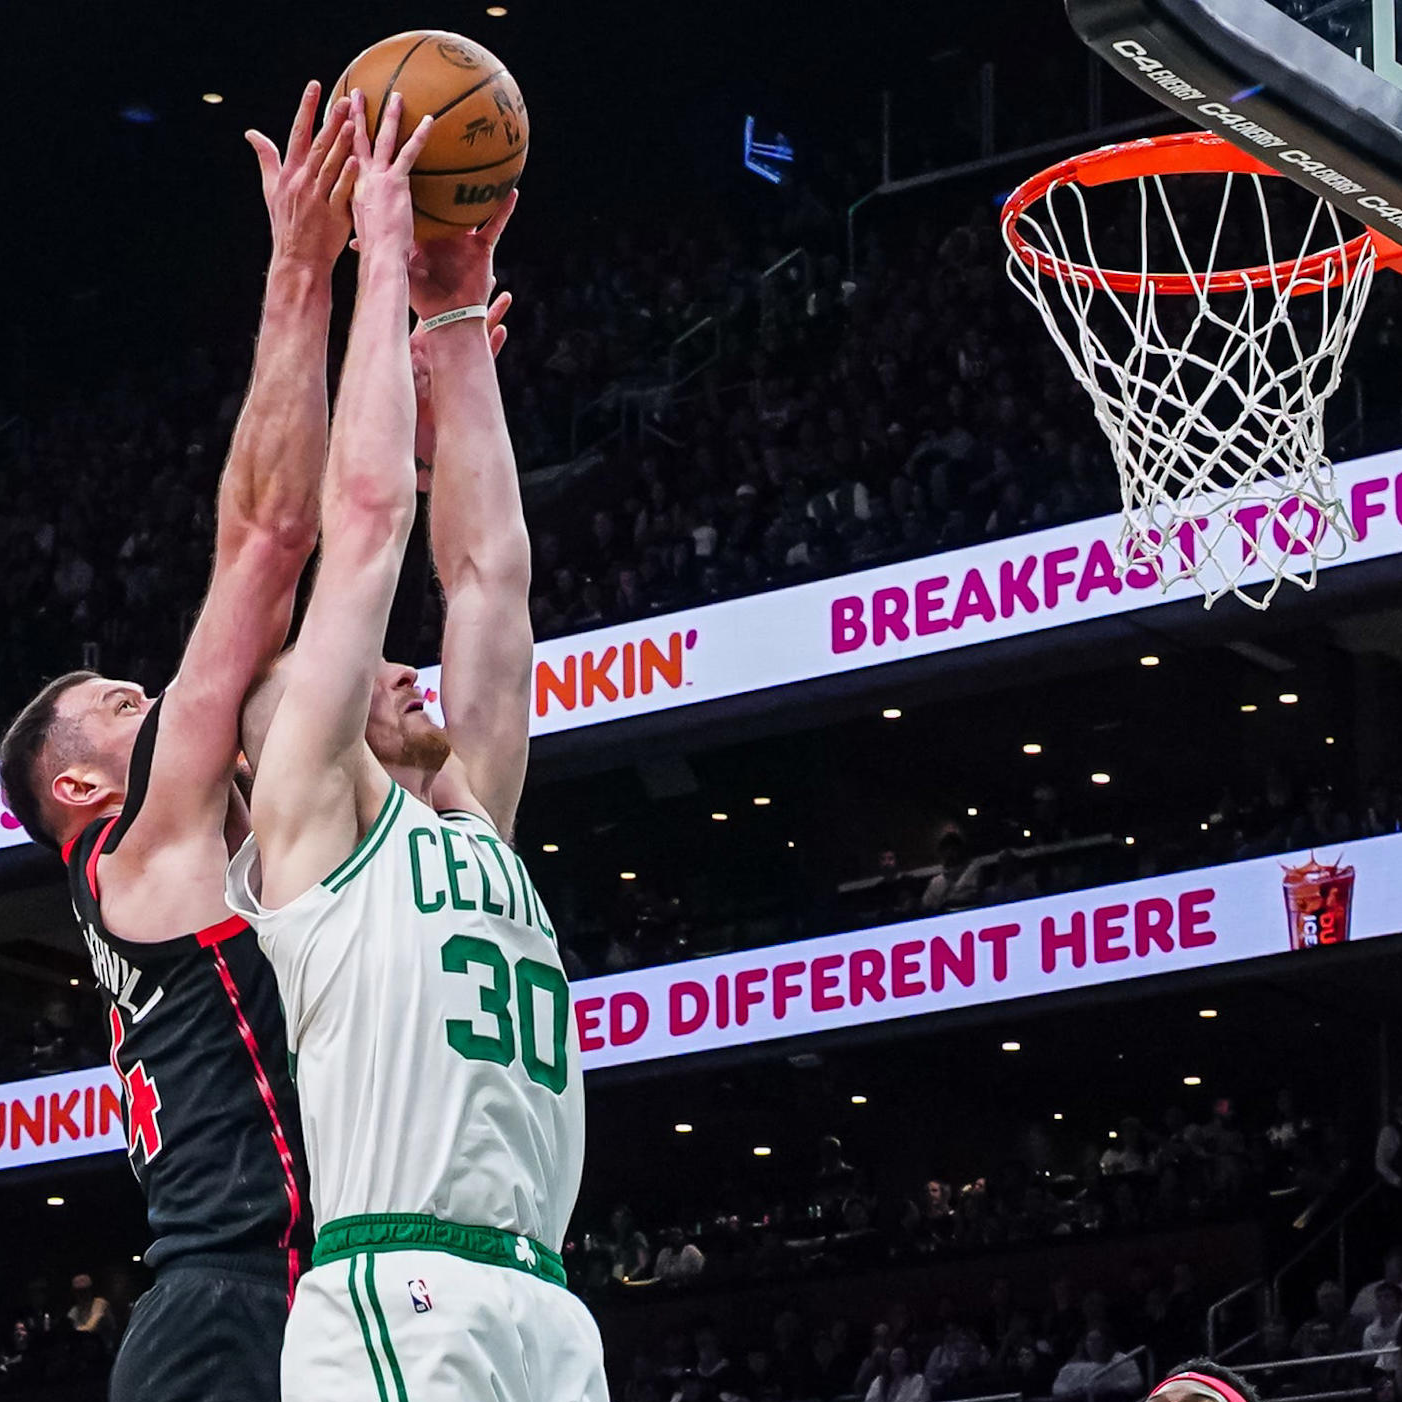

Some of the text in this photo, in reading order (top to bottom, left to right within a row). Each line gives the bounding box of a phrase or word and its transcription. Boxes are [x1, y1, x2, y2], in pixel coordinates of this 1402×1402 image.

[1112, 40, 1206, 101] C4 ENERGY
[1198, 102, 1287, 149] C4 ENERGY
[1278, 150, 1367, 195] C4 ENERGY
[1357, 196, 1402, 222] C4
[832, 519, 1208, 653] BREAKFAST
[1232, 498, 1325, 565] TO
[537, 630, 697, 716] NKIN'
[575, 889, 1216, 1051] ED DIFFERENT HERE
[442, 935, 569, 1095] 30
